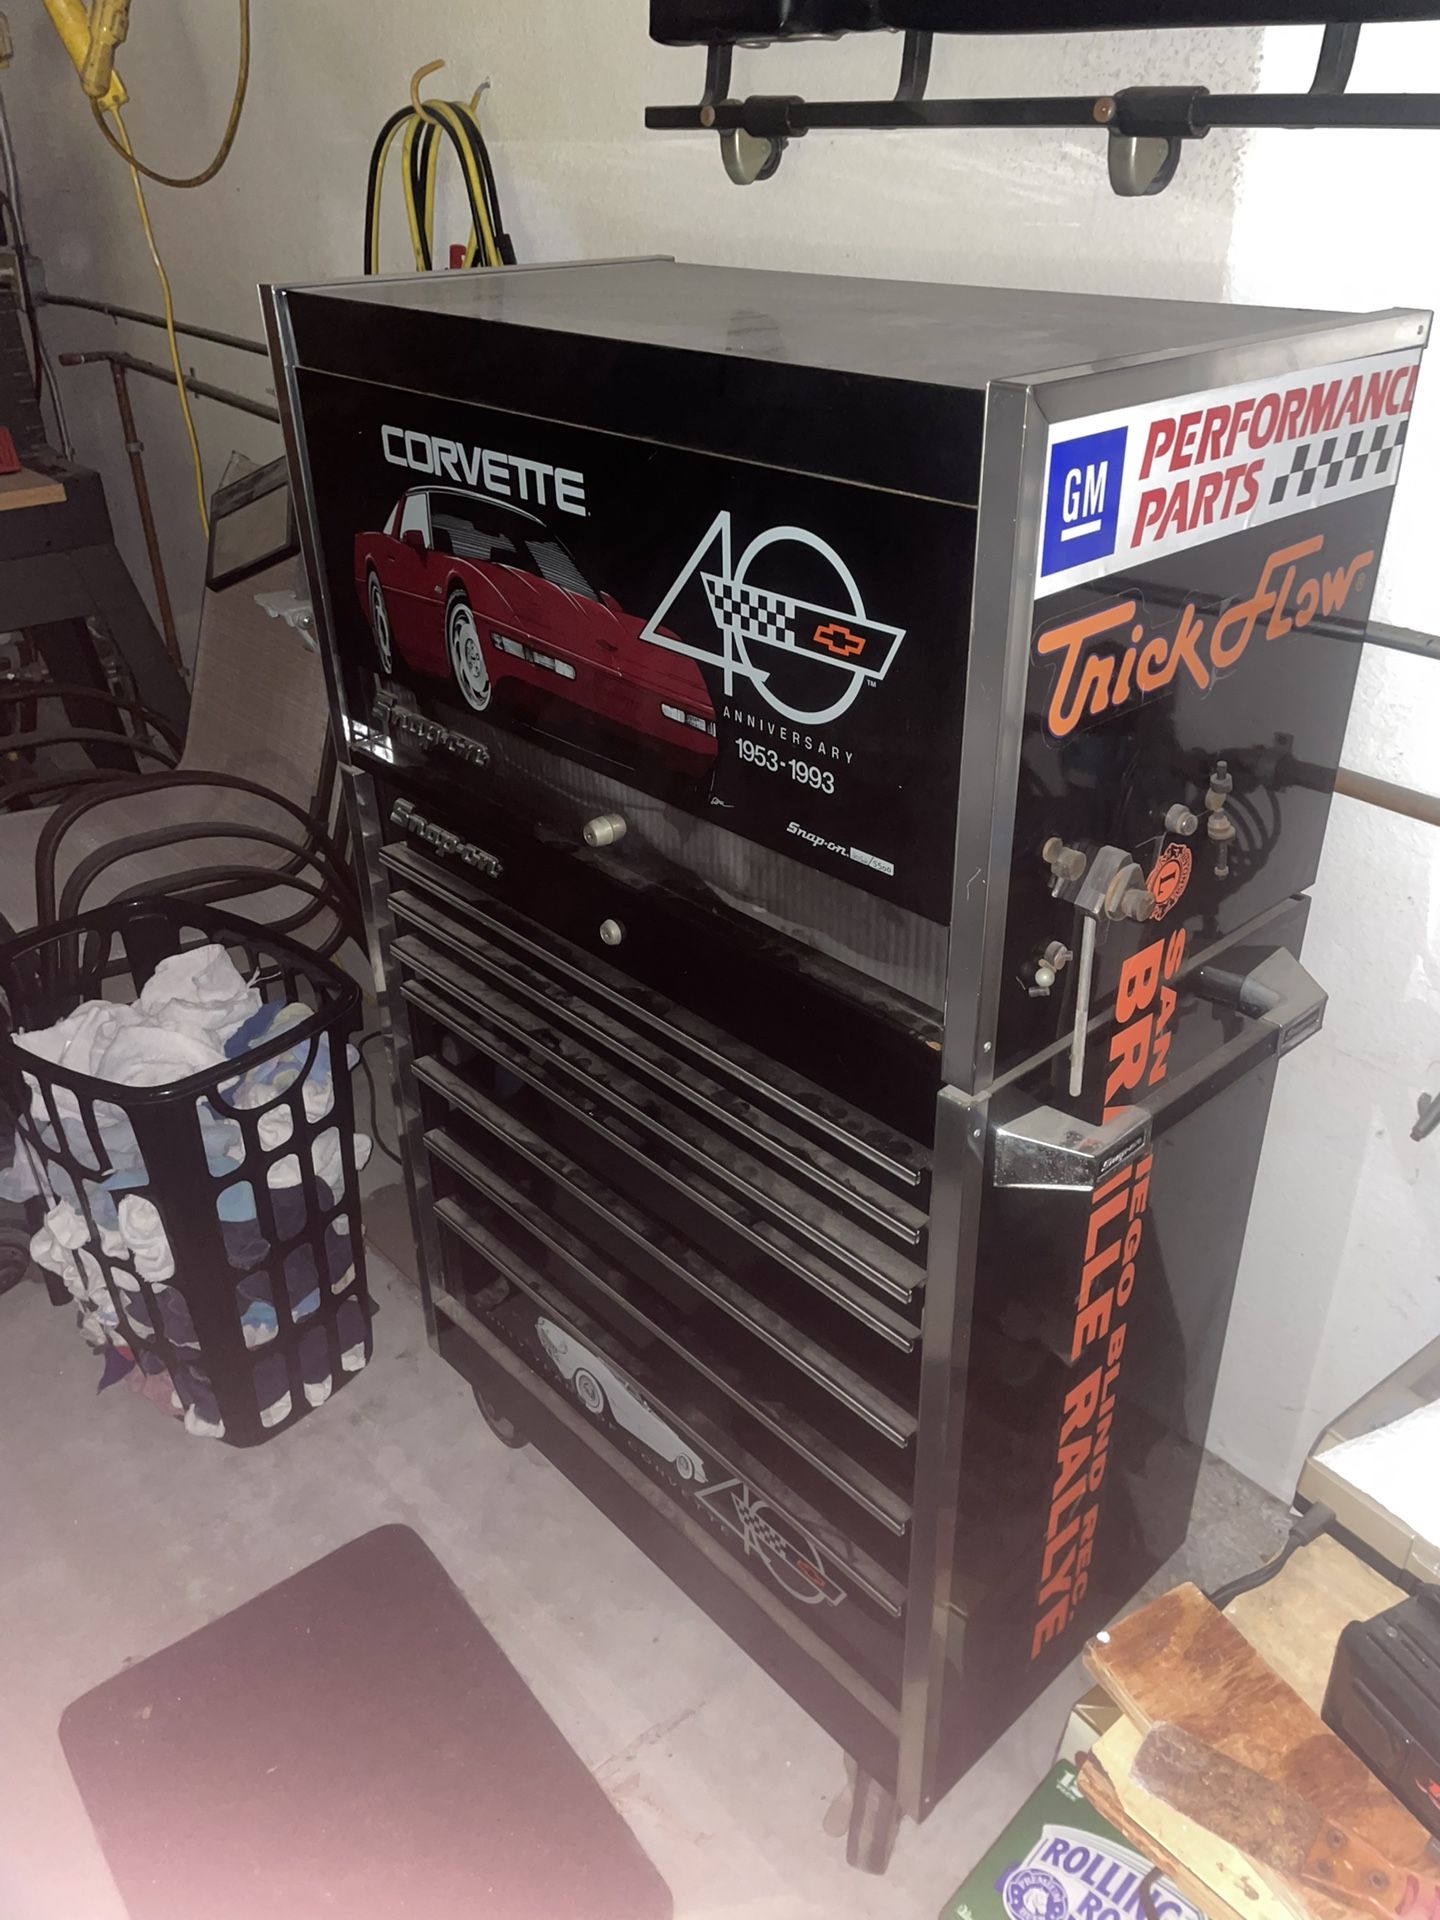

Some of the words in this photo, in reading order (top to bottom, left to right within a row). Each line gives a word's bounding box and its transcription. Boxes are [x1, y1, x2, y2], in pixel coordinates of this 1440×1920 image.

[381, 424, 588, 516] CORVETTE
[1061, 461, 1108, 523] GM
[1130, 458, 1265, 549] PARTS
[723, 705, 854, 764] ANNIVERSARY
[735, 738, 835, 794] 1953-1993
[1148, 927, 1187, 1087] SAN
[1086, 1320, 1127, 1494] BLIND
[1030, 1365, 1103, 1661] RALLYE
